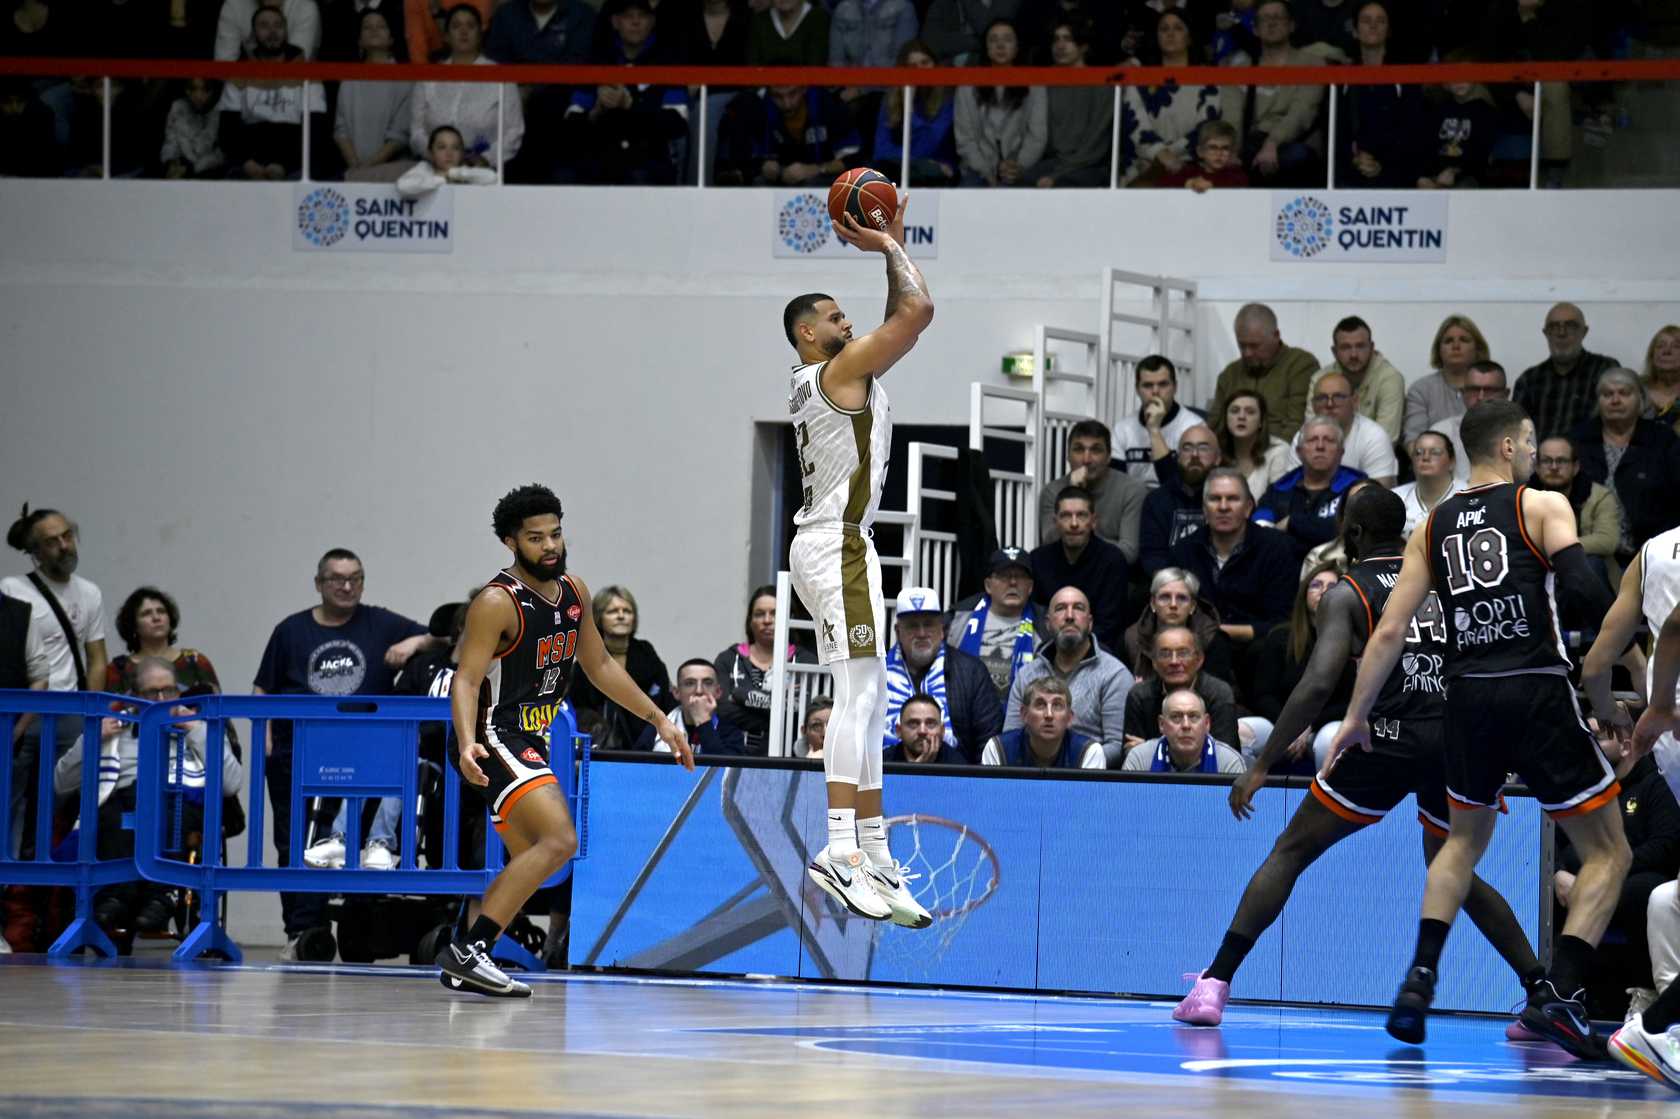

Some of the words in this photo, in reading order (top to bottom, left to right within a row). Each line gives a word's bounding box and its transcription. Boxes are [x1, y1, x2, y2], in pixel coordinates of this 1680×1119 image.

[355, 198, 418, 216] SAINT
[1338, 207, 1408, 225] SAINT
[355, 220, 449, 240] QUENTIN
[1338, 229, 1442, 250] QUENTIN
[1442, 527, 1509, 596] 18
[1472, 594, 1526, 625] OPTI
[855, 624, 867, 635] 50
[536, 629, 577, 669] MSB
[538, 666, 560, 696] 12
[1374, 717, 1400, 740] 44
